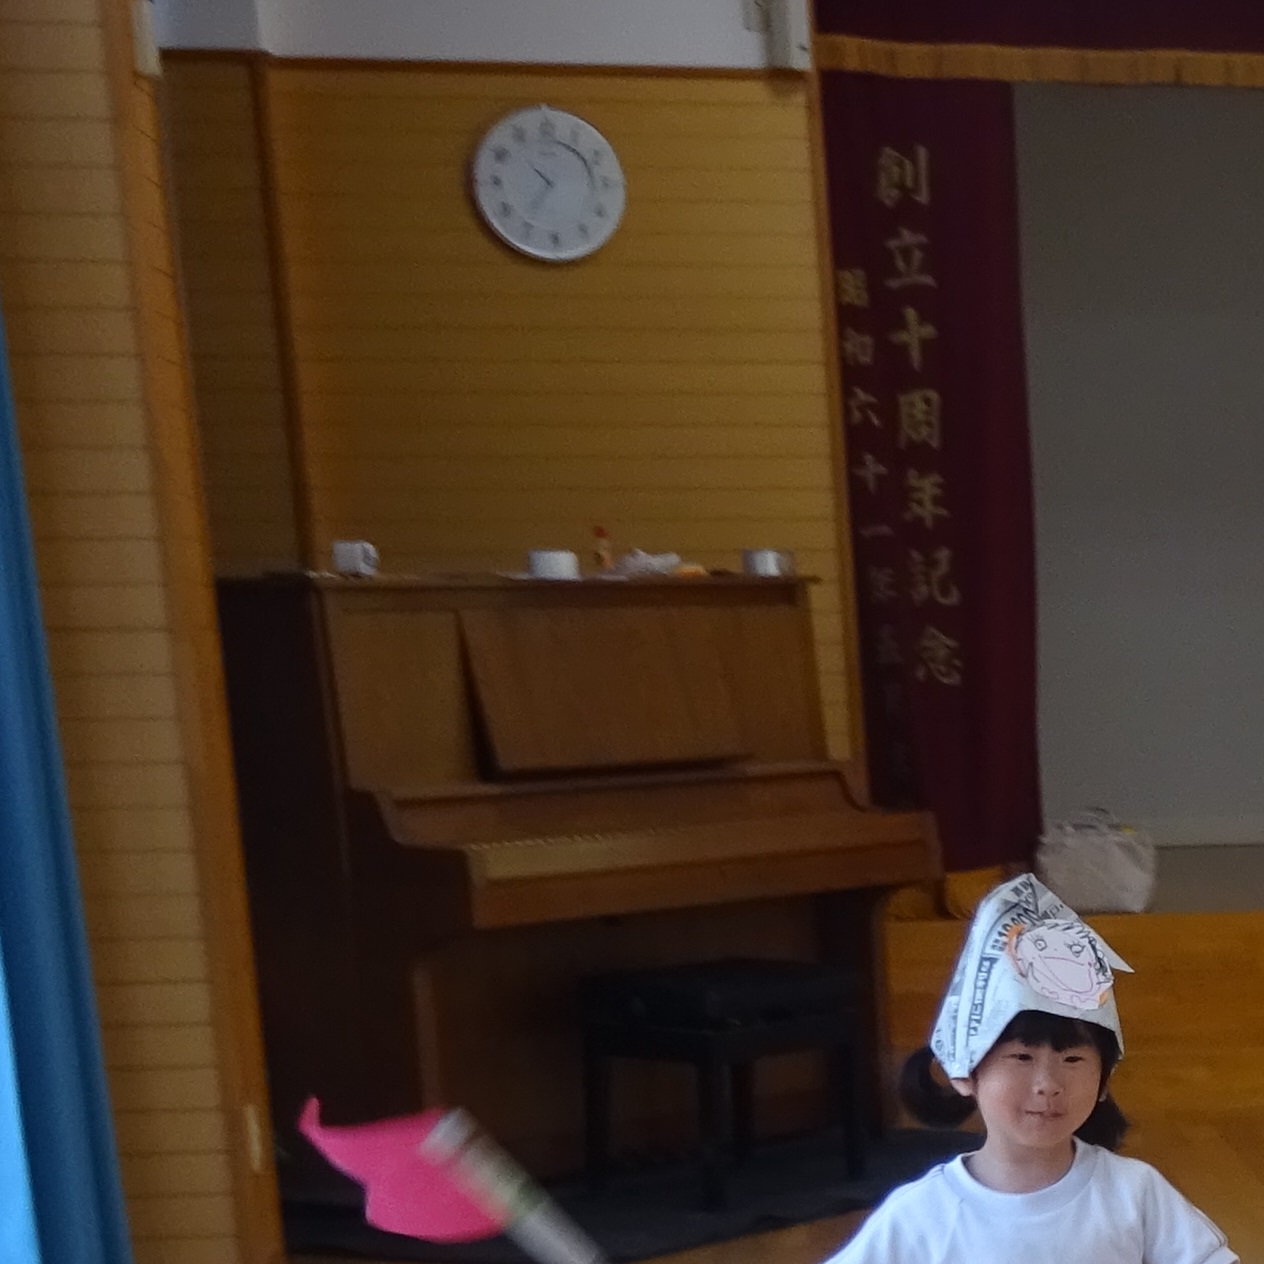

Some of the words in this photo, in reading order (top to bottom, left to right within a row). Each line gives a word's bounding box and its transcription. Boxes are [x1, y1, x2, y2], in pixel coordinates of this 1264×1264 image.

[875, 143, 962, 687] 創立十周年記念
